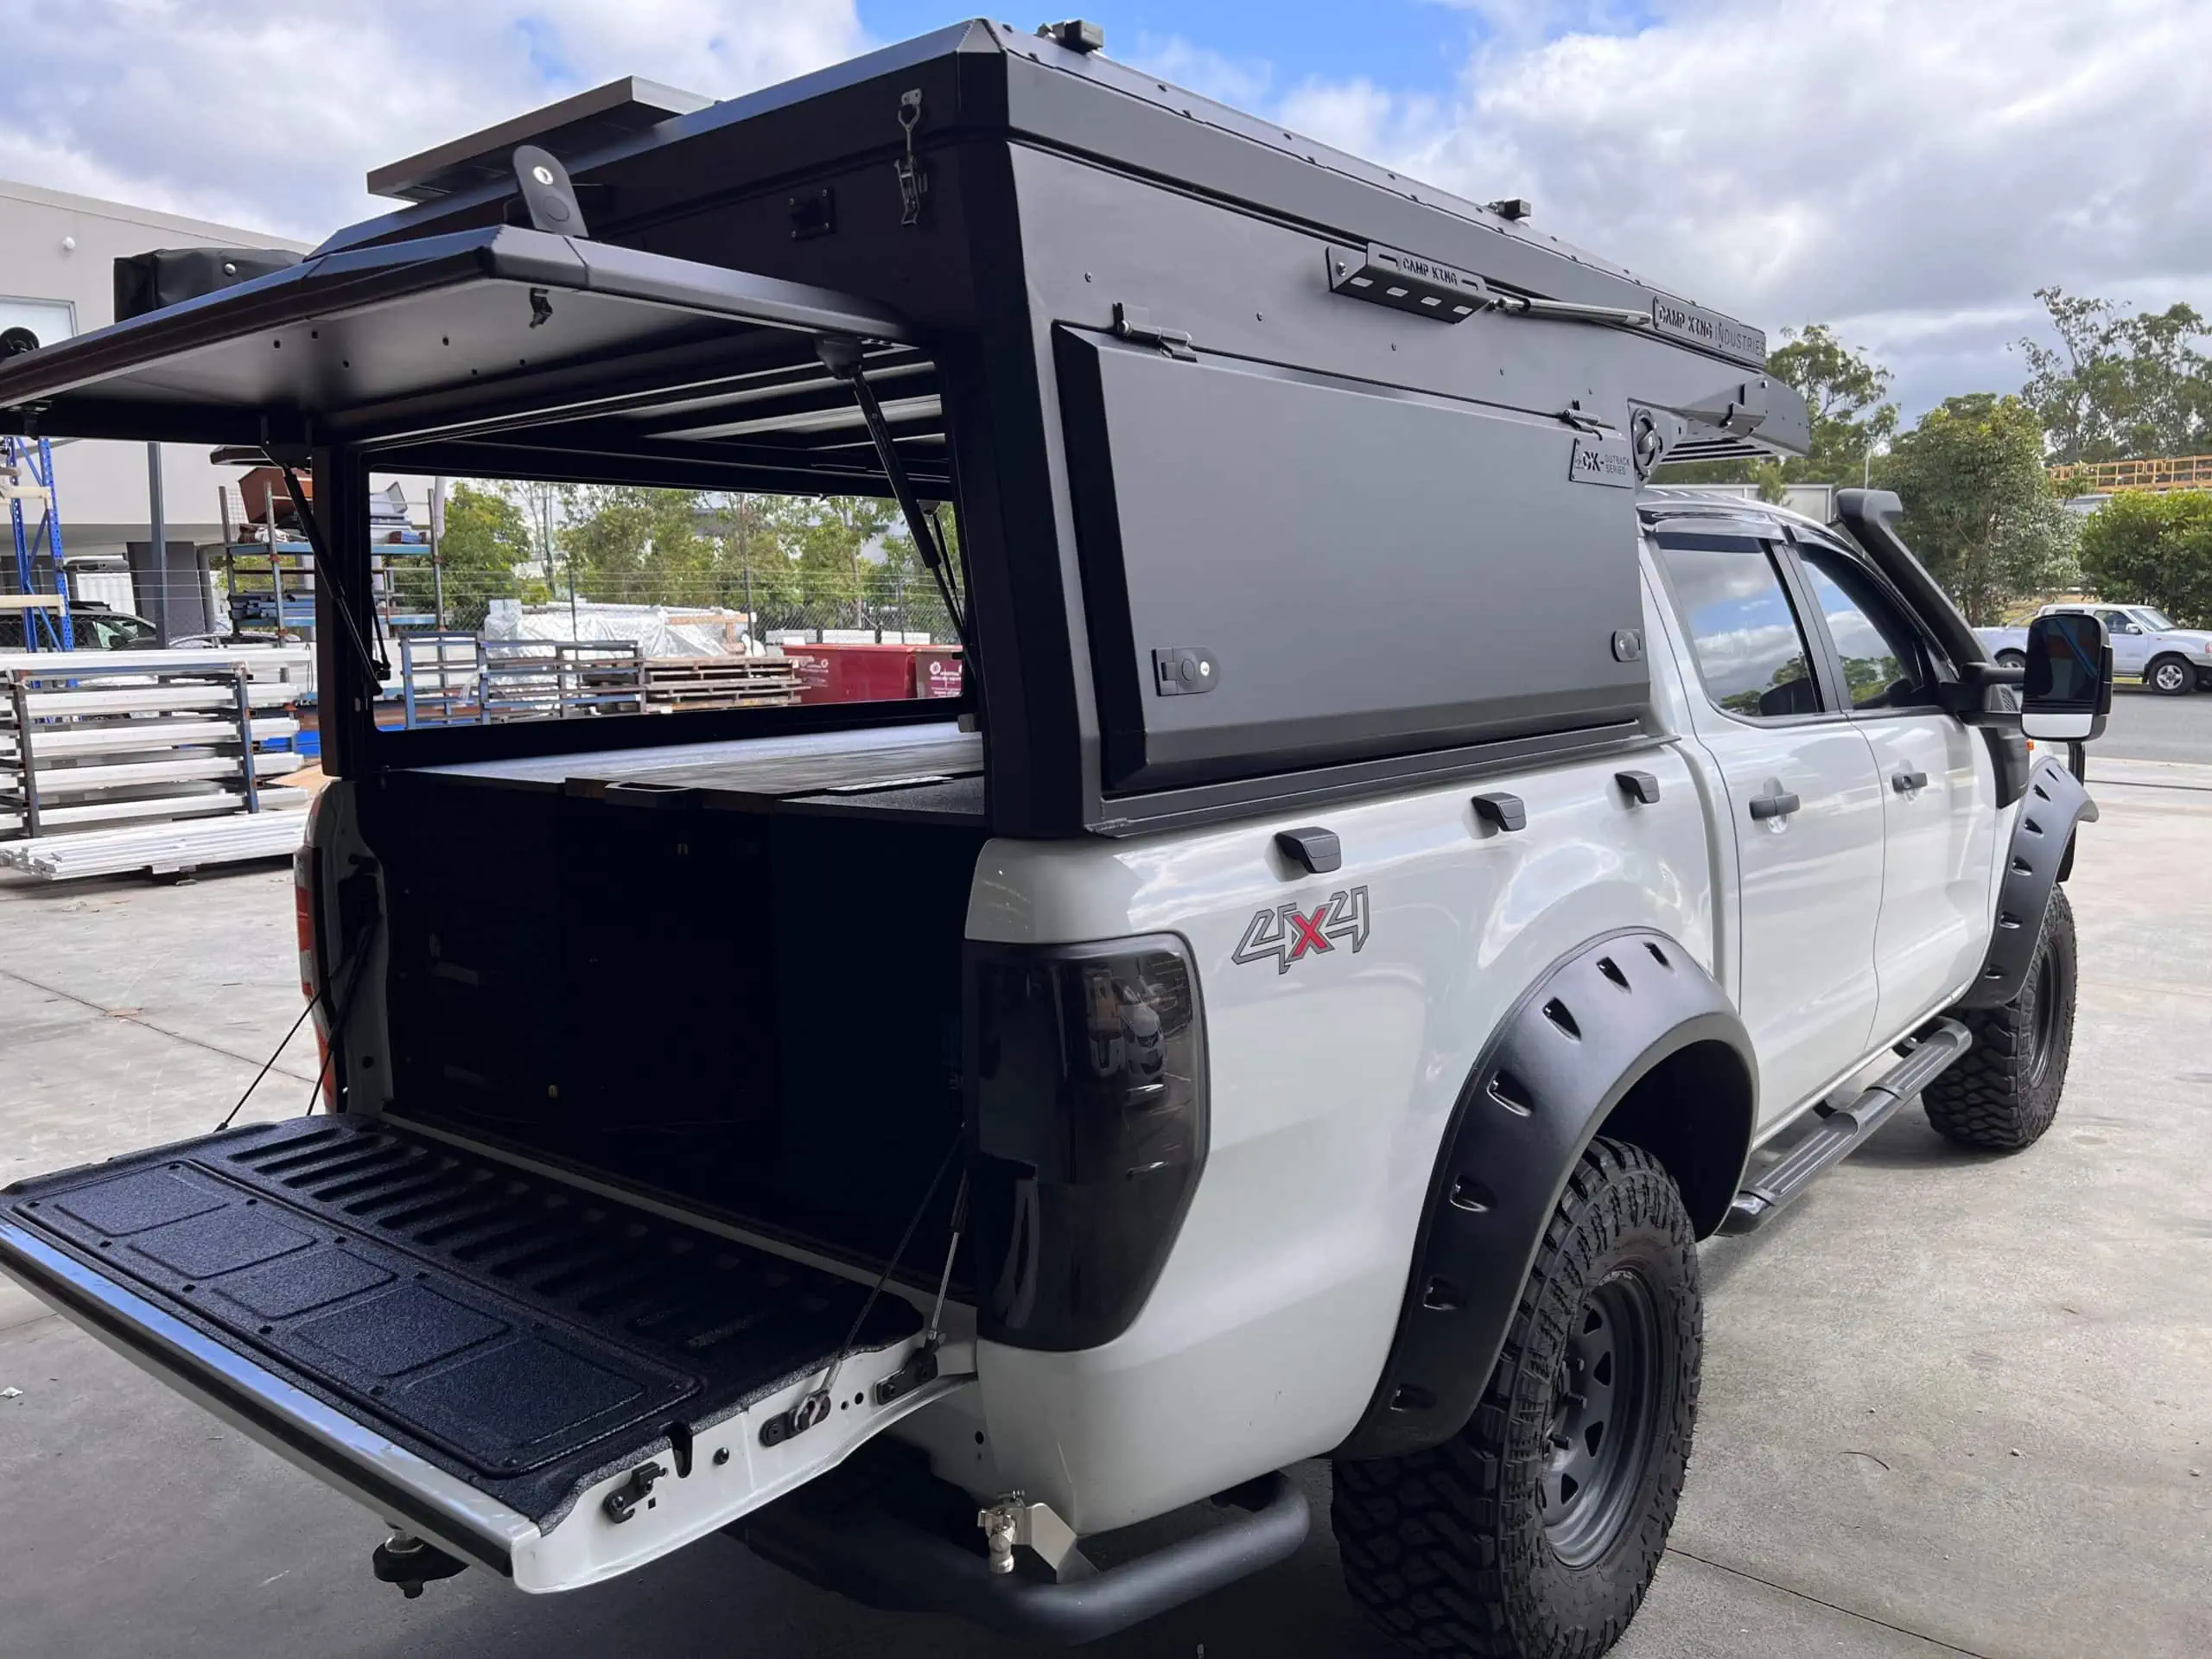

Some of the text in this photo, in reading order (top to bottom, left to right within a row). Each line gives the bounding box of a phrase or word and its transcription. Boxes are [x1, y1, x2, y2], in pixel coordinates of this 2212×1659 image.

[1402, 257, 1459, 286] CAMP KING
[1659, 304, 1766, 357] CAMP KING INDUSTRIES
